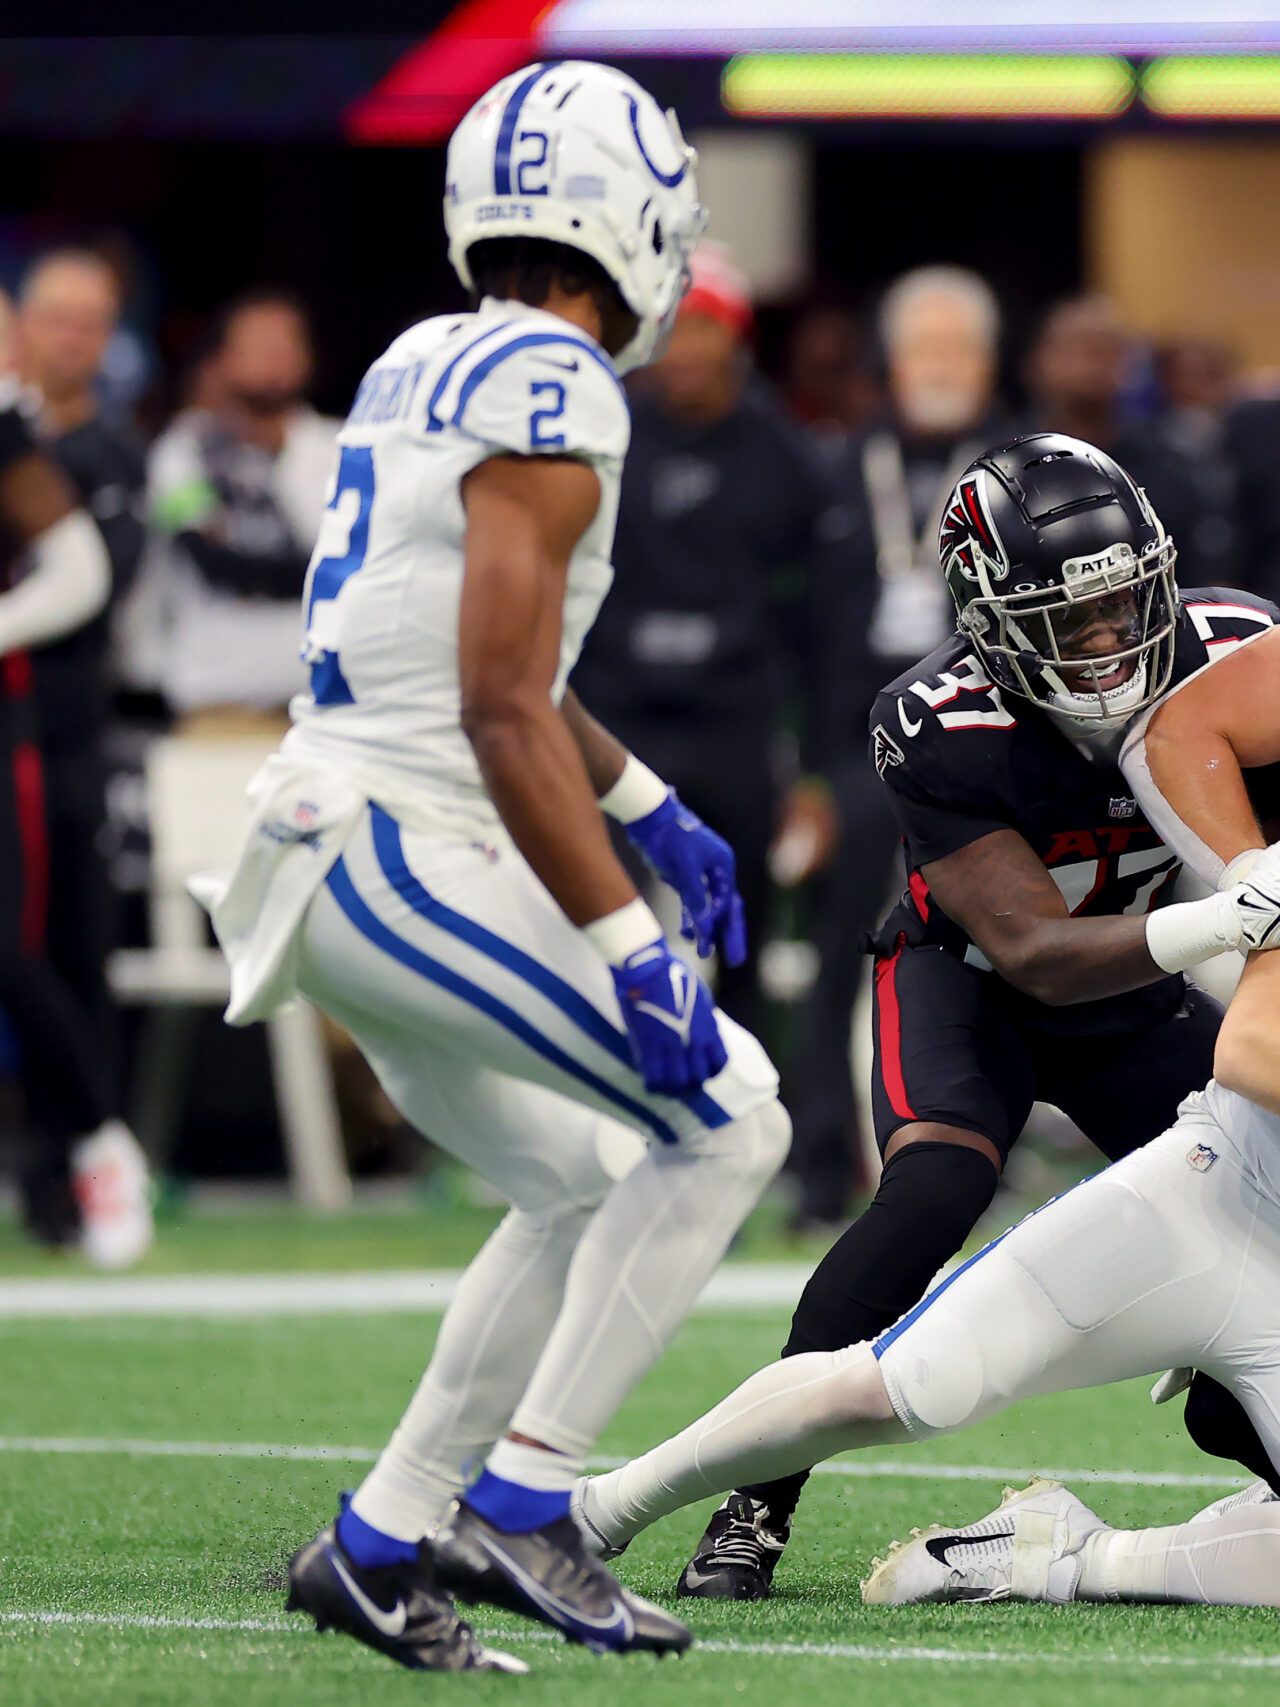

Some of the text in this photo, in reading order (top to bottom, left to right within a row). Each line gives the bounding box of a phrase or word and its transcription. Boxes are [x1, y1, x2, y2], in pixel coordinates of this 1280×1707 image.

[516, 131, 548, 195] 2
[530, 382, 566, 447] 2
[1081, 556, 1115, 574] ATL
[907, 654, 1019, 731] 37
[1042, 825, 1166, 864] AT
